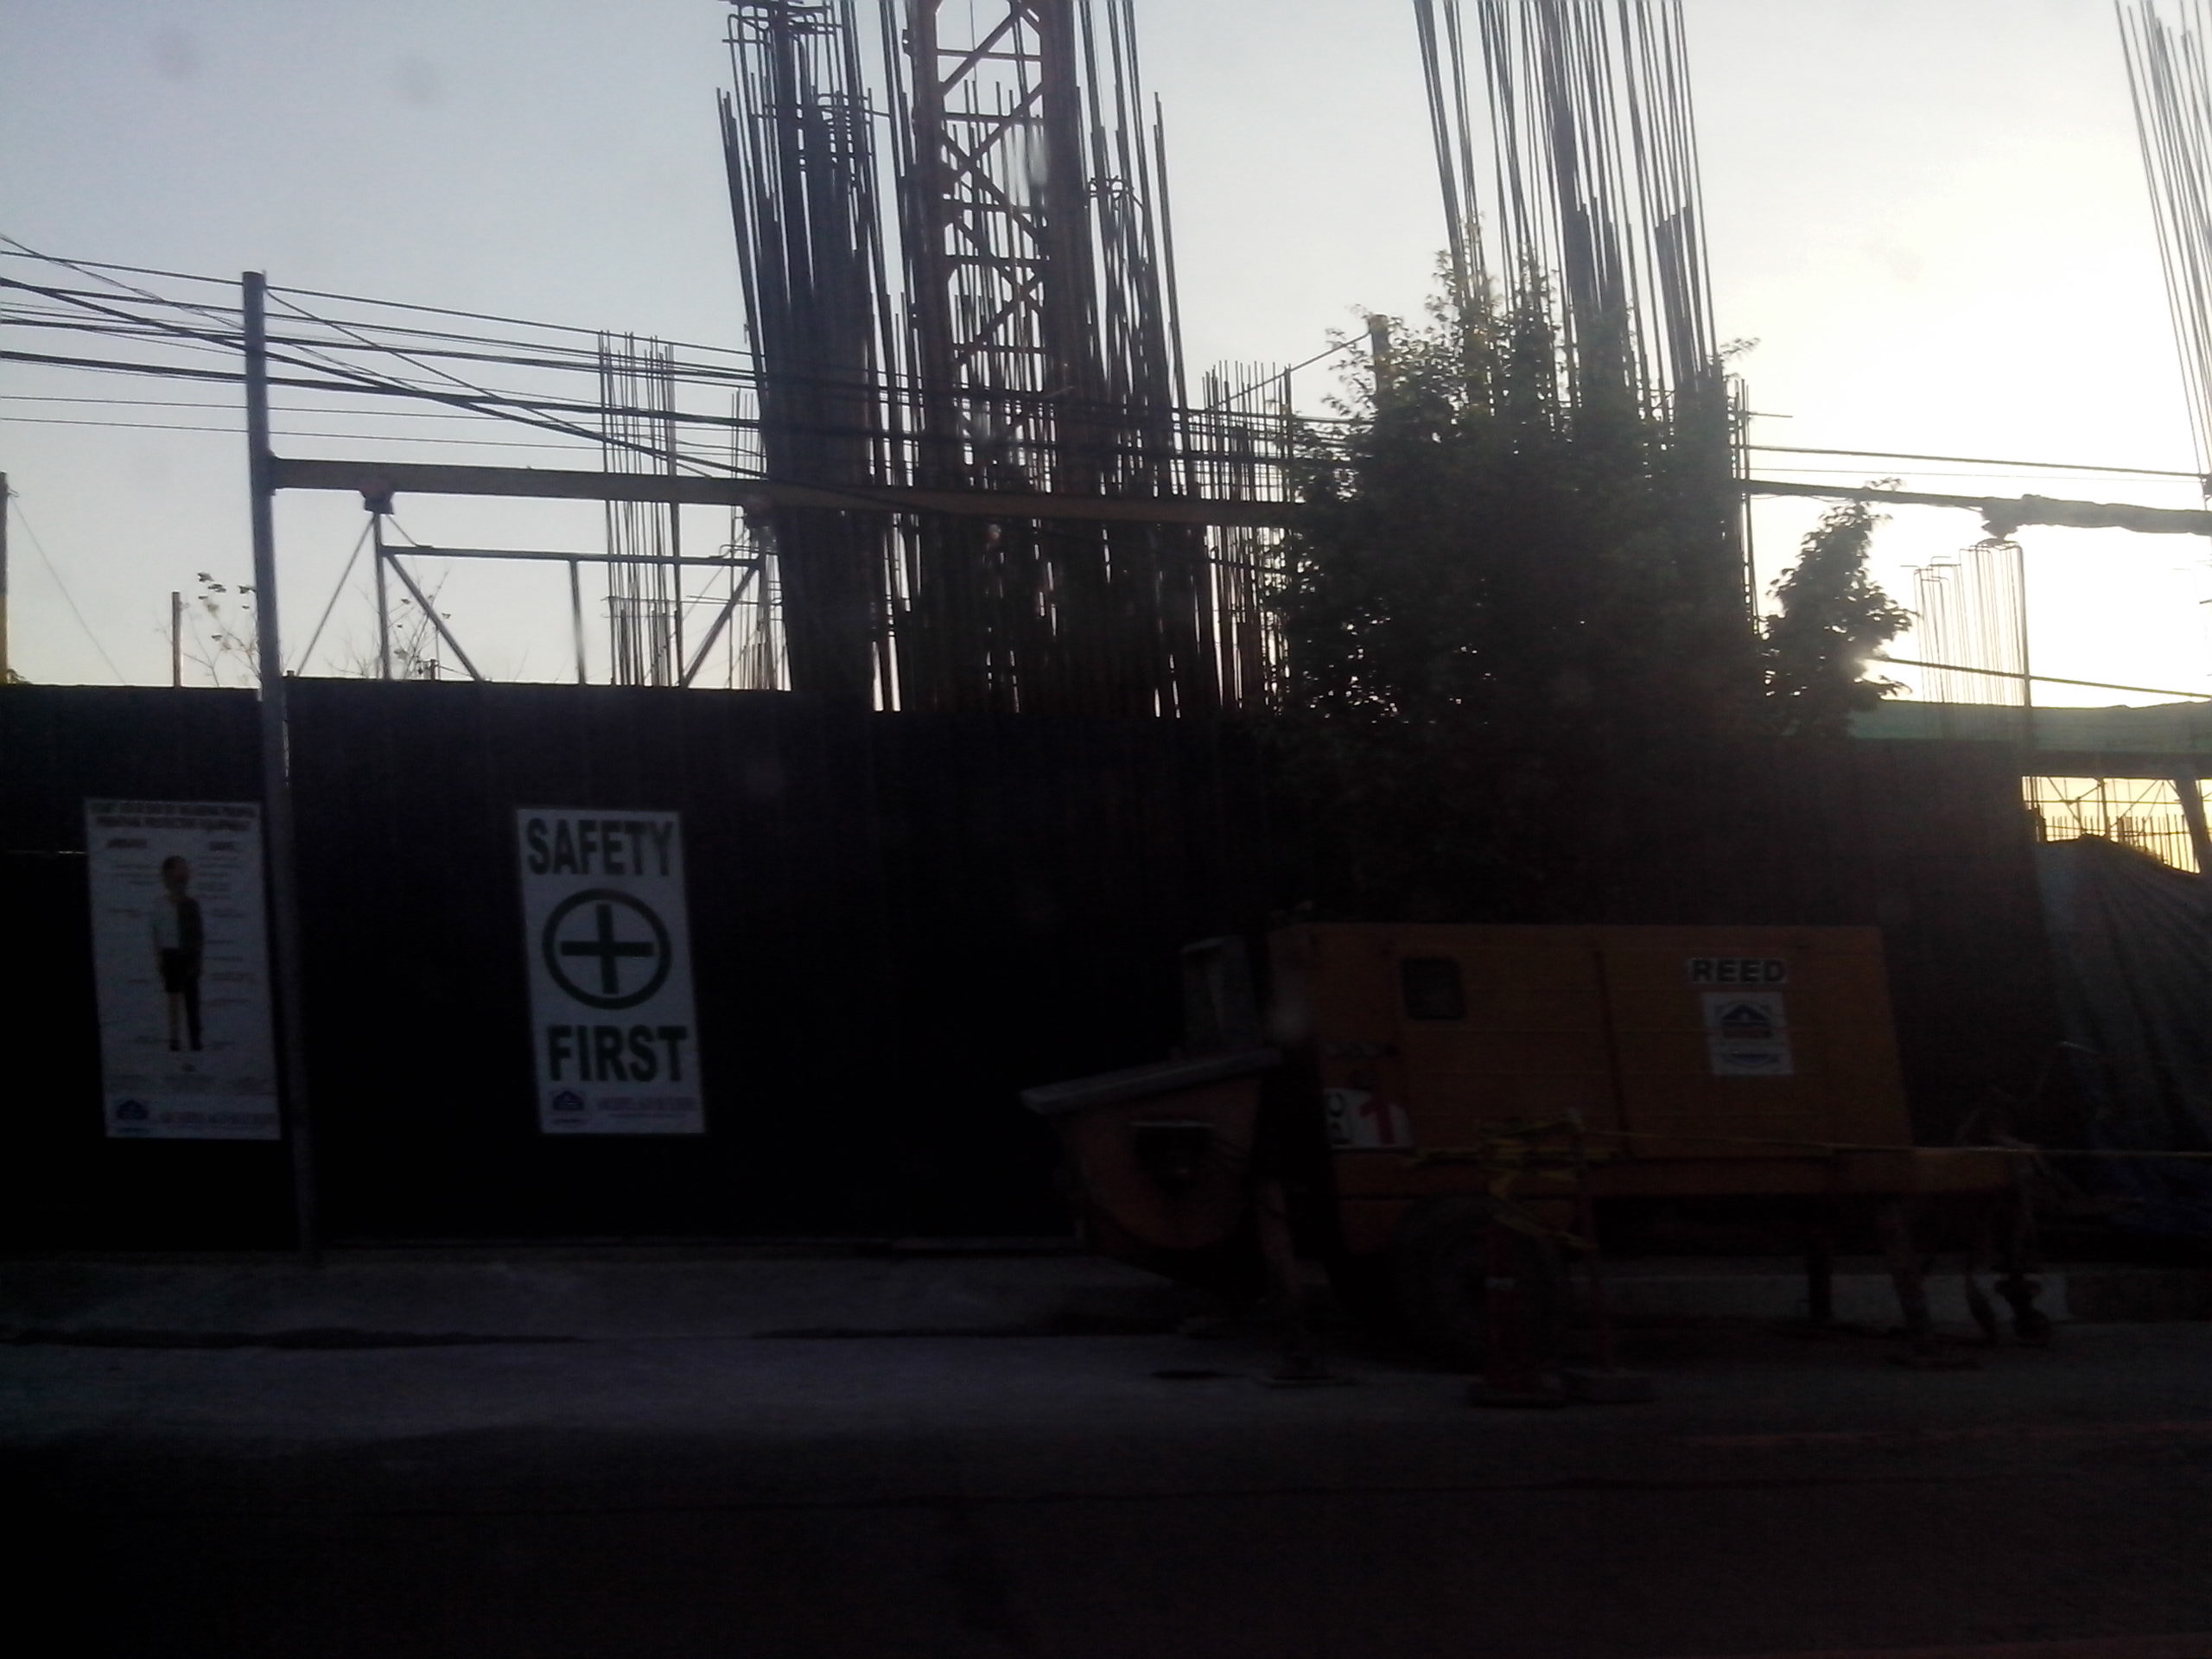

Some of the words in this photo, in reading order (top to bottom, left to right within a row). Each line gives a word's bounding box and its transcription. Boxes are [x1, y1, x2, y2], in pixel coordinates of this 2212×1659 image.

[527, 817, 674, 876] SAFETY
[1694, 959, 1784, 982] REED
[548, 1025, 688, 1081] FIRST
